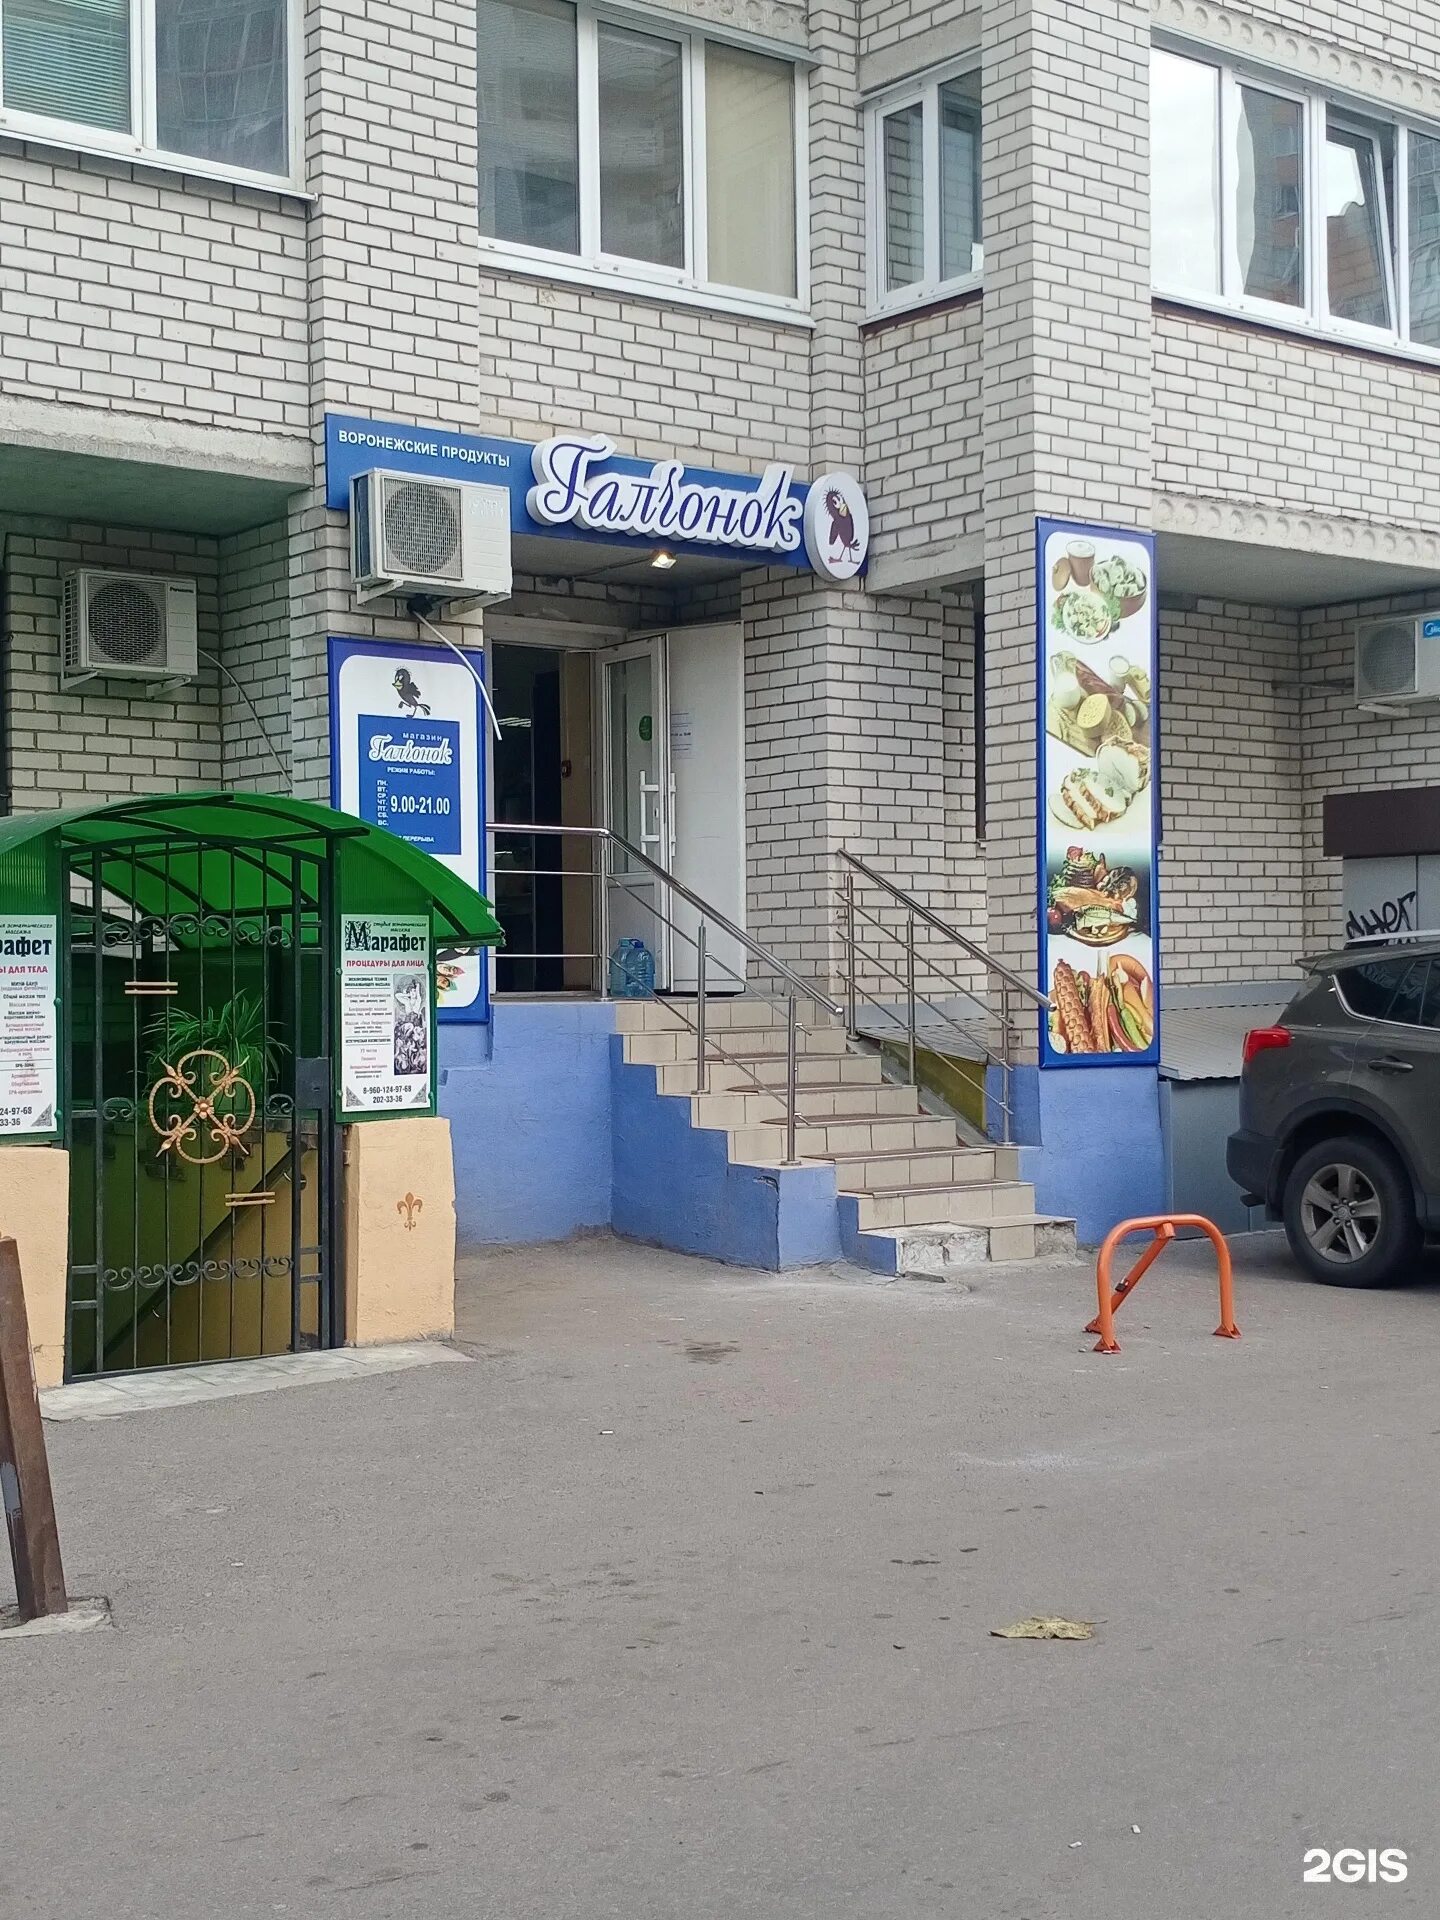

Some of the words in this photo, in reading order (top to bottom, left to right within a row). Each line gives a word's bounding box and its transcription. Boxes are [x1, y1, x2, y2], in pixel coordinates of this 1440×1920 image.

[338, 429, 438, 457] ВОРОНЕЖСКИЕ
[441, 445, 511, 468] ПРОДУКТЫ
[402, 732, 443, 742] магазин
[387, 766, 409, 774] РЕЖИМ
[390, 795, 450, 815] 9.00-21.00
[345, 920, 427, 953] Марафет
[8, 966, 26, 974] ДЛЯ
[373, 1095, 403, 1104] 202-33-36
